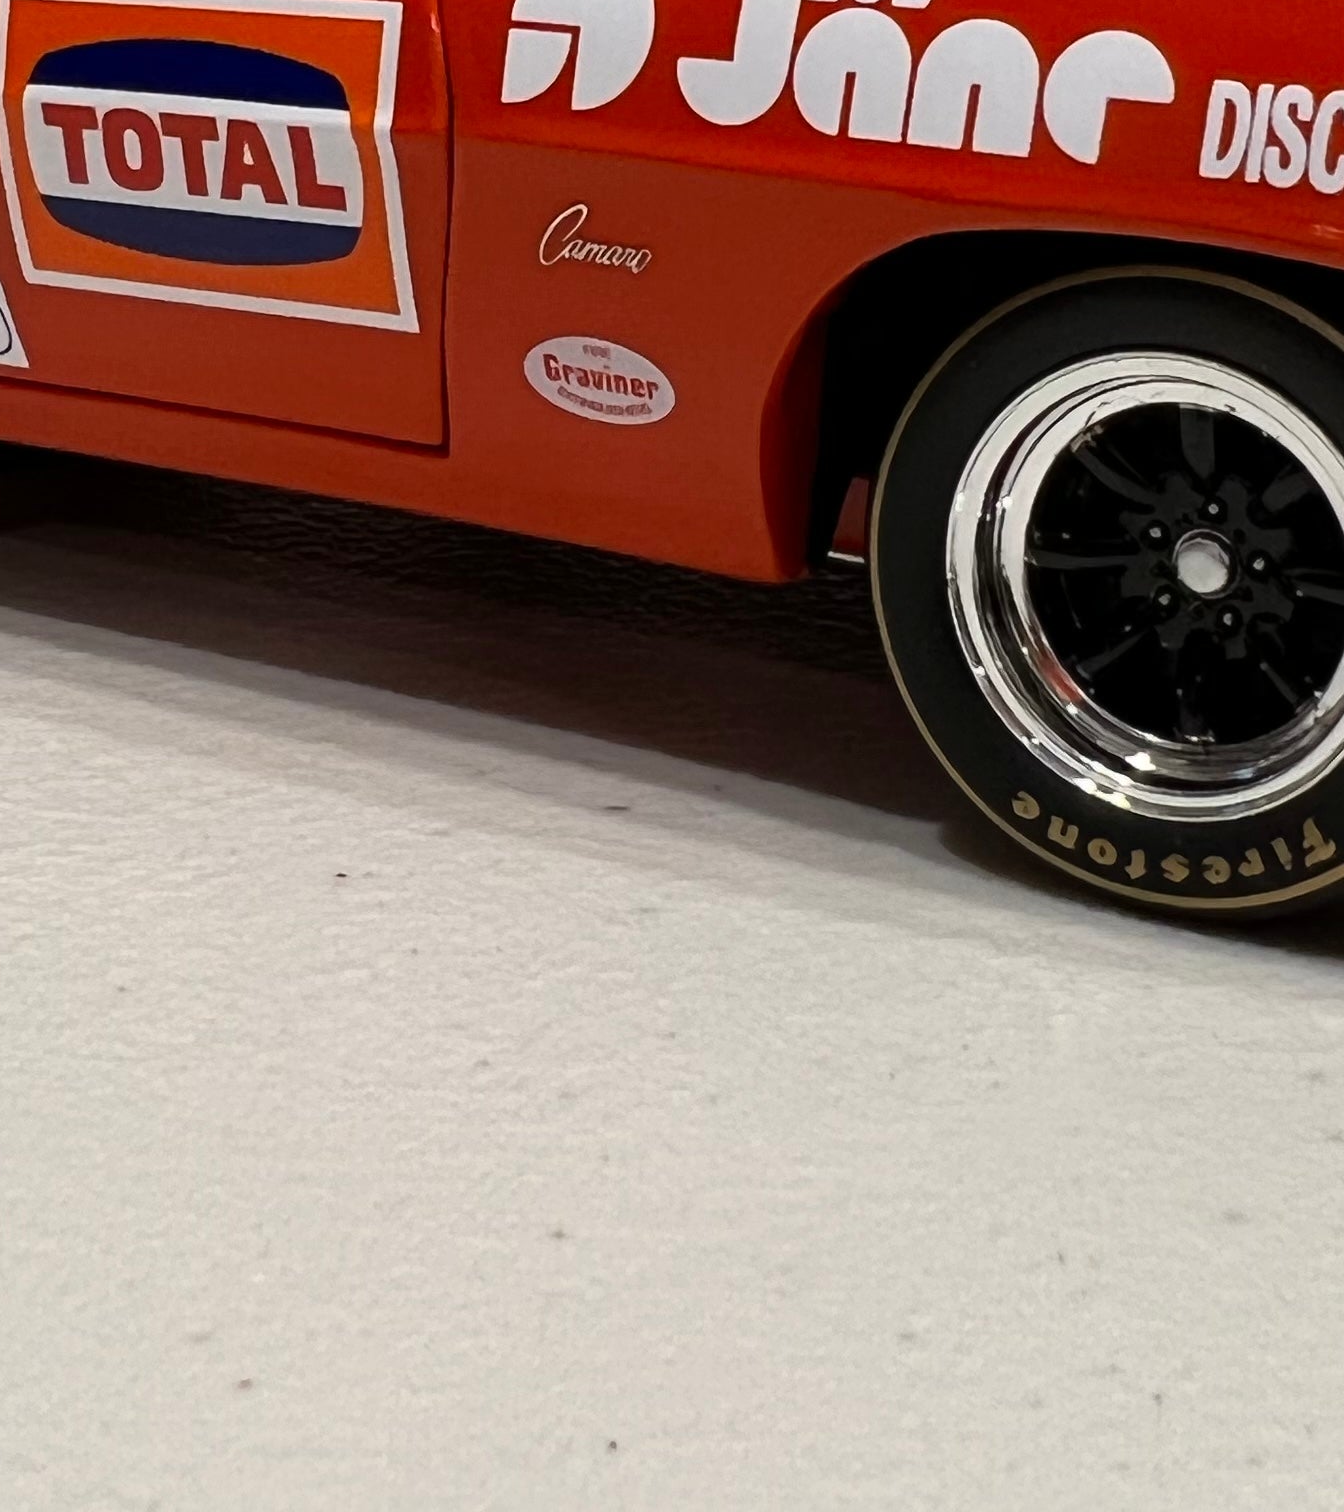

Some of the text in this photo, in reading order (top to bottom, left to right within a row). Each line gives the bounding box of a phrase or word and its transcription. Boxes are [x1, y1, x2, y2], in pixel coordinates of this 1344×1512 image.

[41, 102, 348, 212] TOTAL
[539, 203, 652, 274] Camaro
[542, 353, 659, 401] Graviner
[1010, 790, 1338, 885] Firestone
